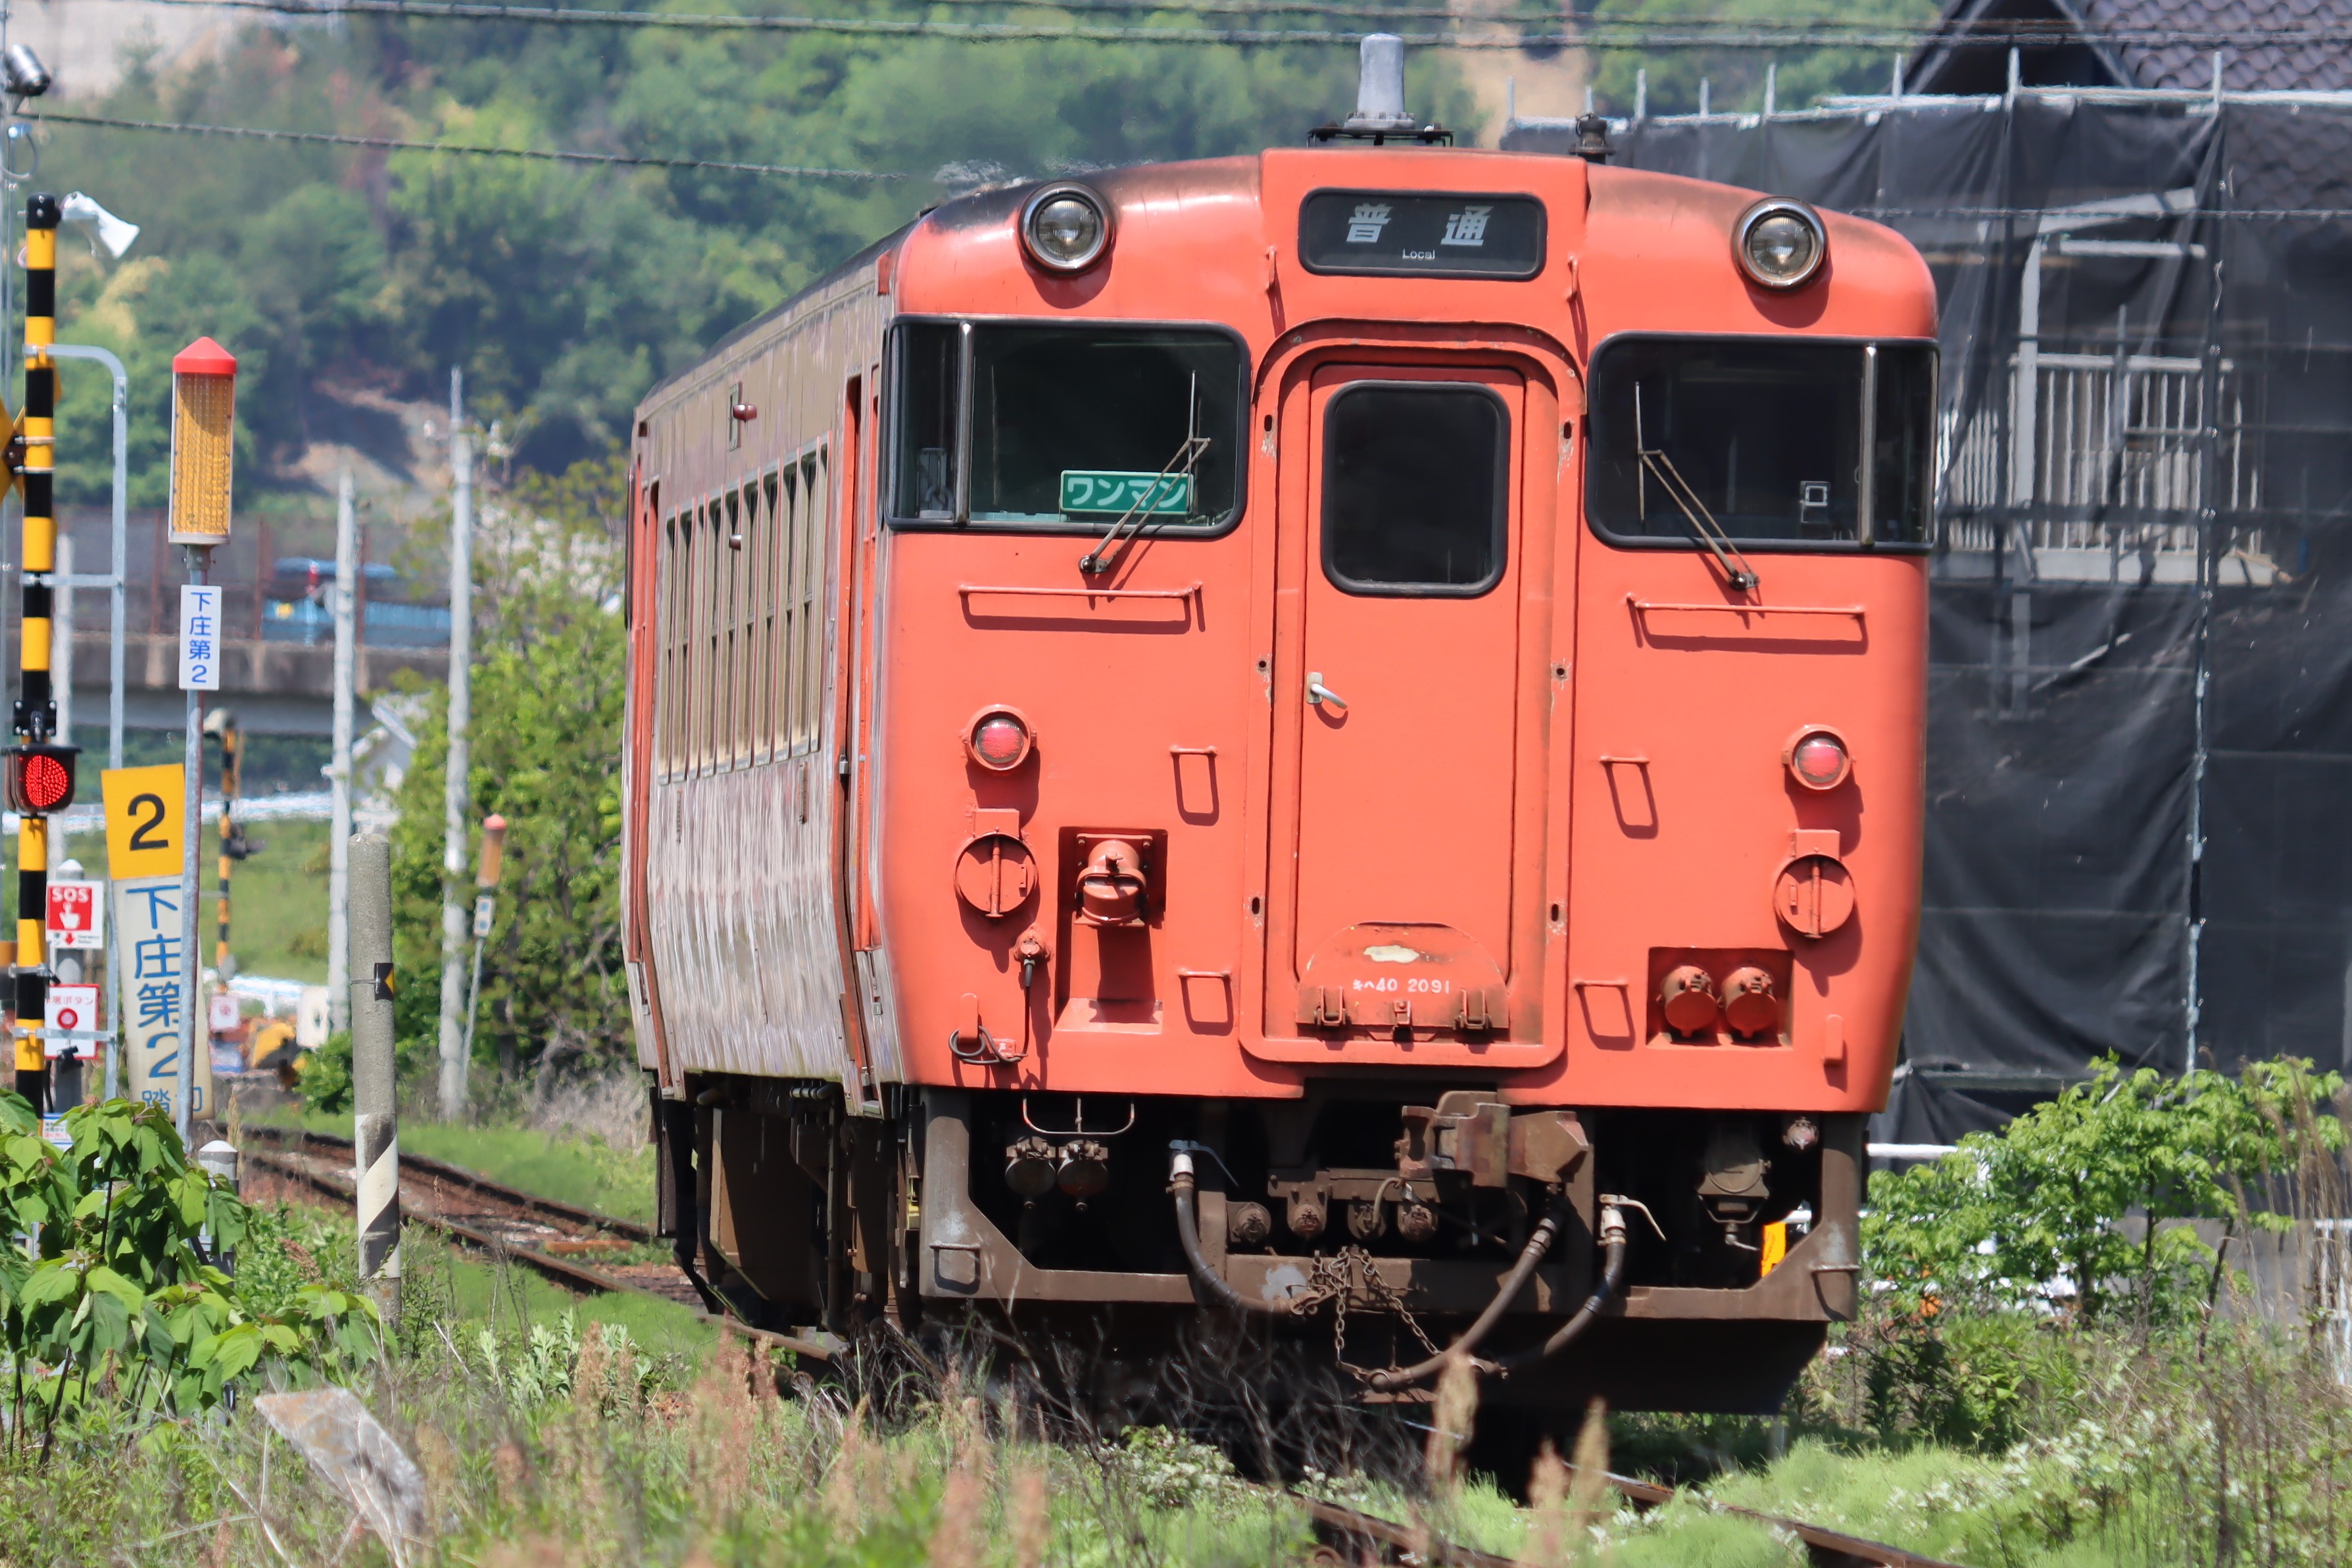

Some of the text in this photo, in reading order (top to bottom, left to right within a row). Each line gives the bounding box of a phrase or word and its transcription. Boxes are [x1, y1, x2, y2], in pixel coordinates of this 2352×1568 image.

[1346, 203, 1494, 246] 普通
[1402, 248, 1435, 259] Local
[1067, 477, 1187, 507] ワンマン
[189, 591, 212, 683] 下庄第2
[128, 793, 169, 851] 2
[51, 886, 89, 903] SOS
[1408, 978, 1450, 994] 2091
